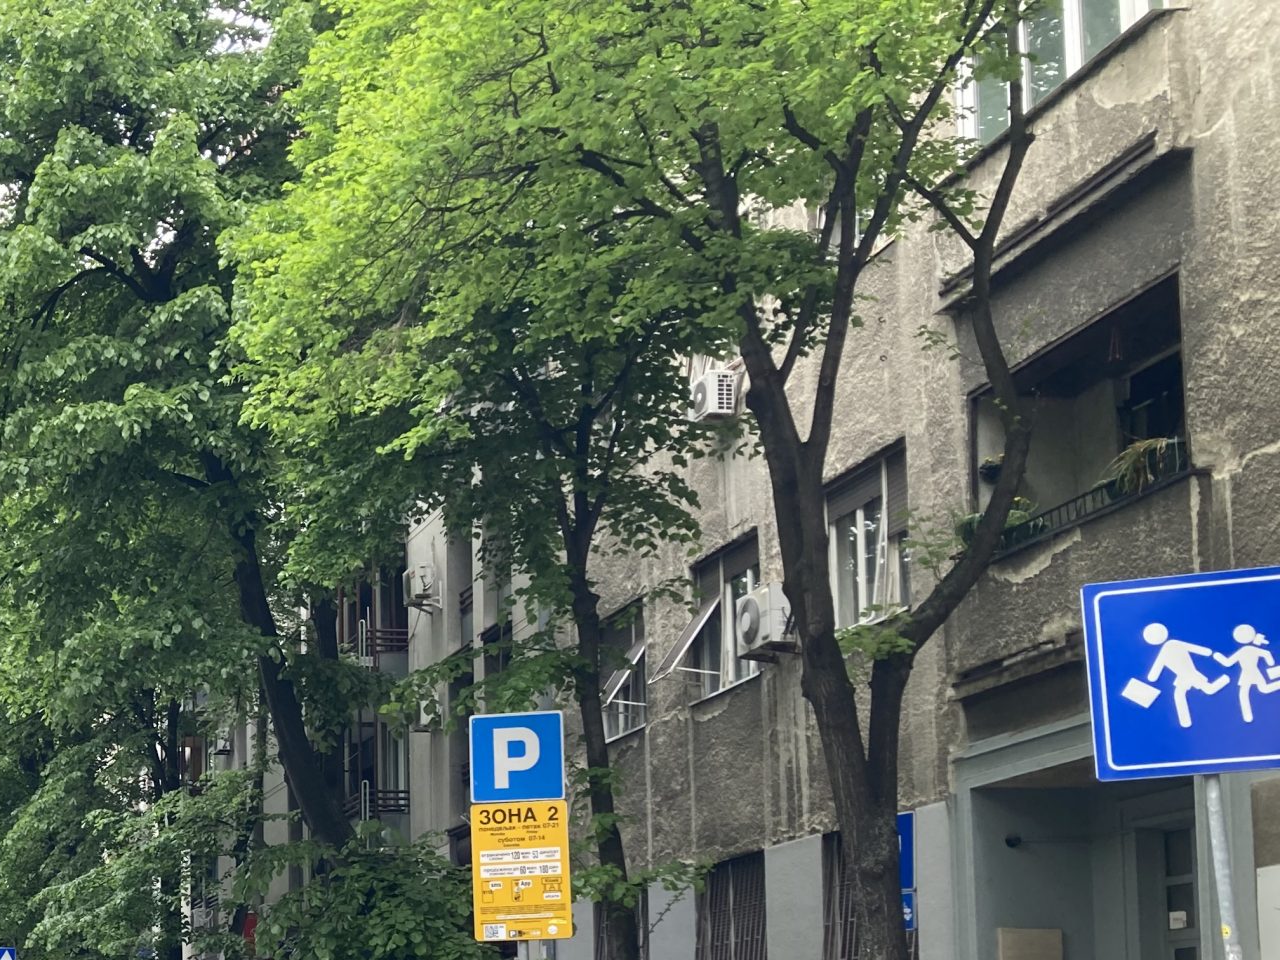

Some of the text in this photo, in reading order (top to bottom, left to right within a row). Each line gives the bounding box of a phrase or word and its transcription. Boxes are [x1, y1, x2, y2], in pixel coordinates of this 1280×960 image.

[493, 727, 540, 789] P
[479, 806, 559, 825] ЗОНА 2
